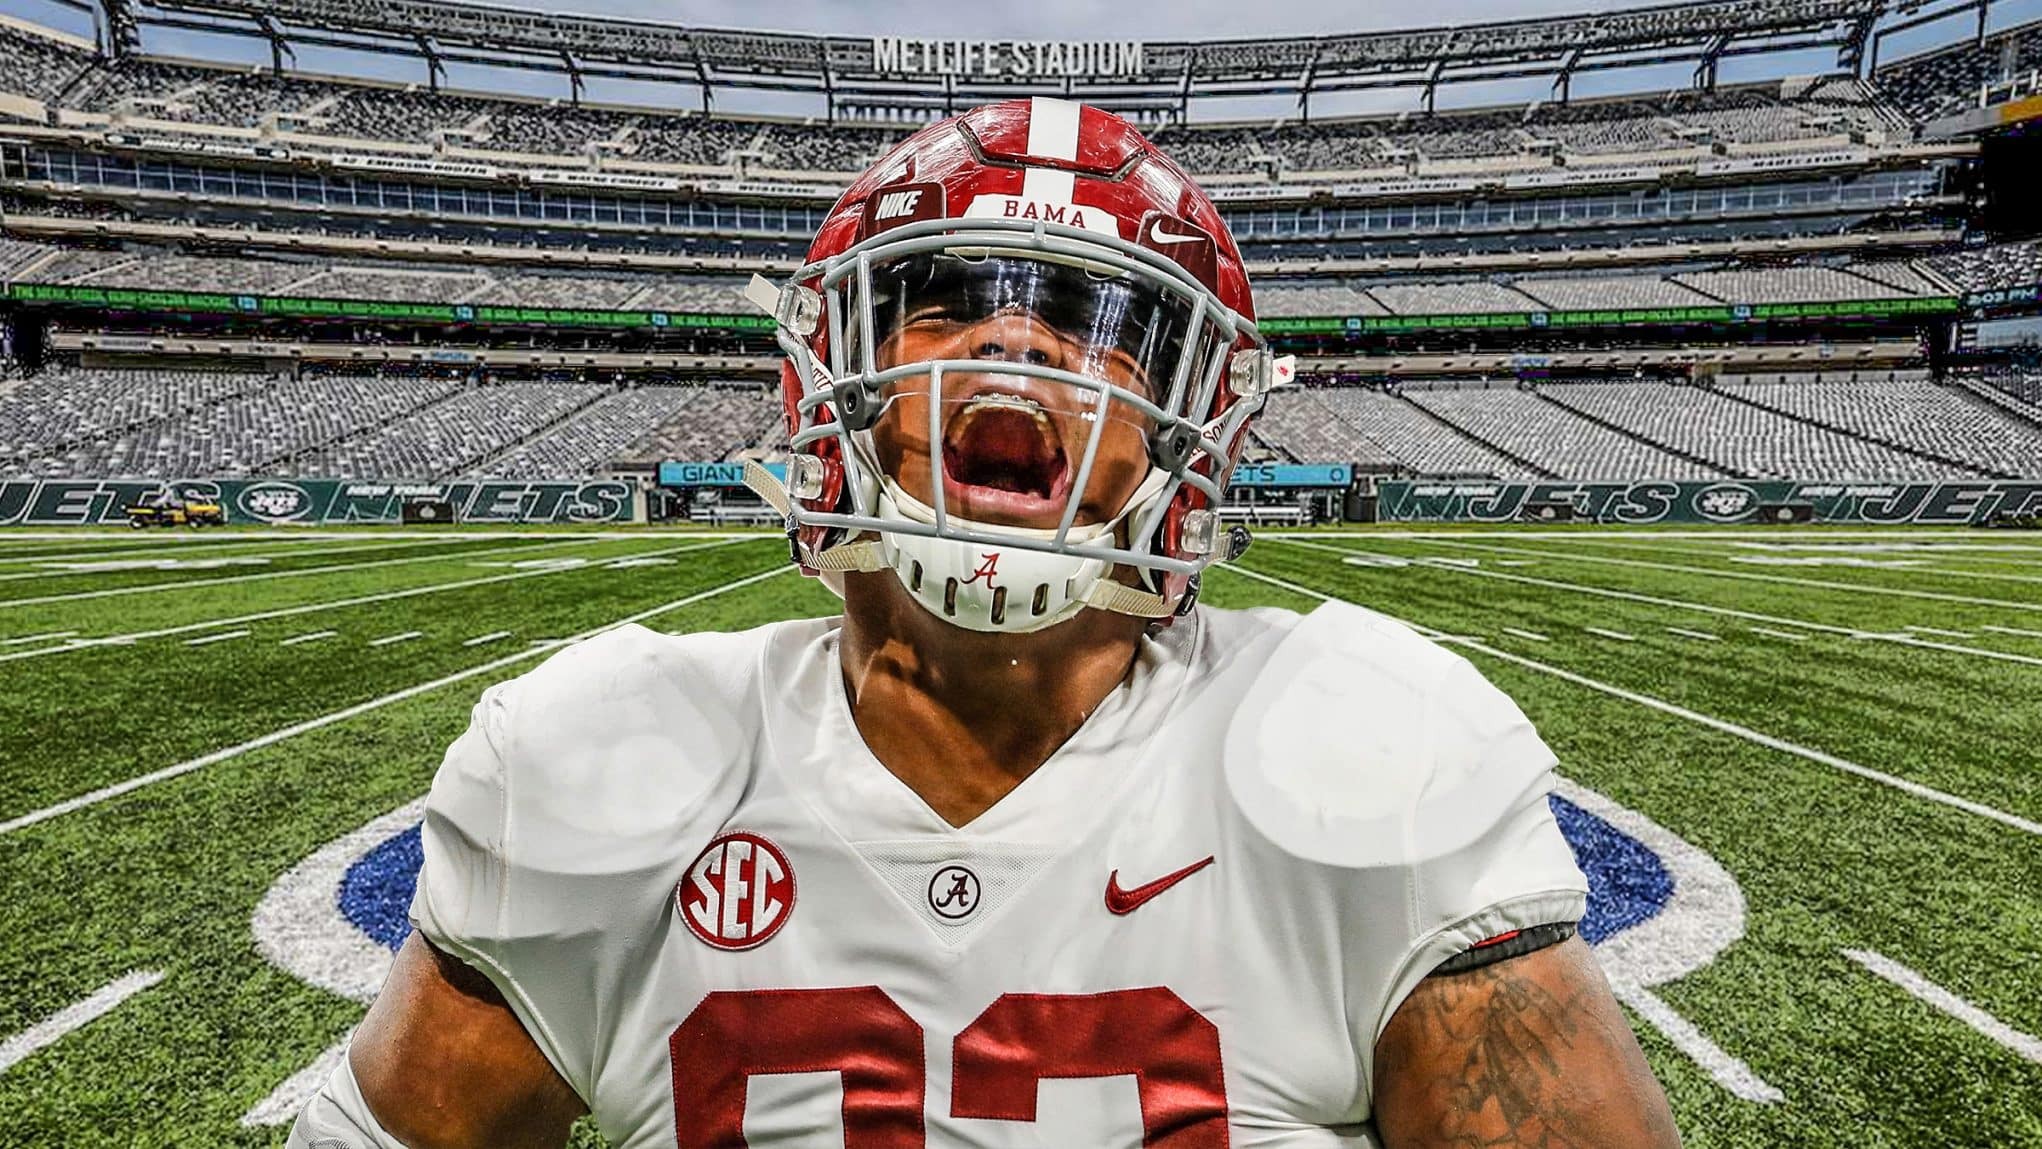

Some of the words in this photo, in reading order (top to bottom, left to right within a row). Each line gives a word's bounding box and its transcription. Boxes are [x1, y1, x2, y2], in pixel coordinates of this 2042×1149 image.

[873, 38, 1000, 75] METLIFE
[1011, 40, 1143, 76] STADIUM
[875, 190, 923, 221] NIKE
[1004, 200, 1086, 229] BAMA
[688, 840, 785, 940] SEC
